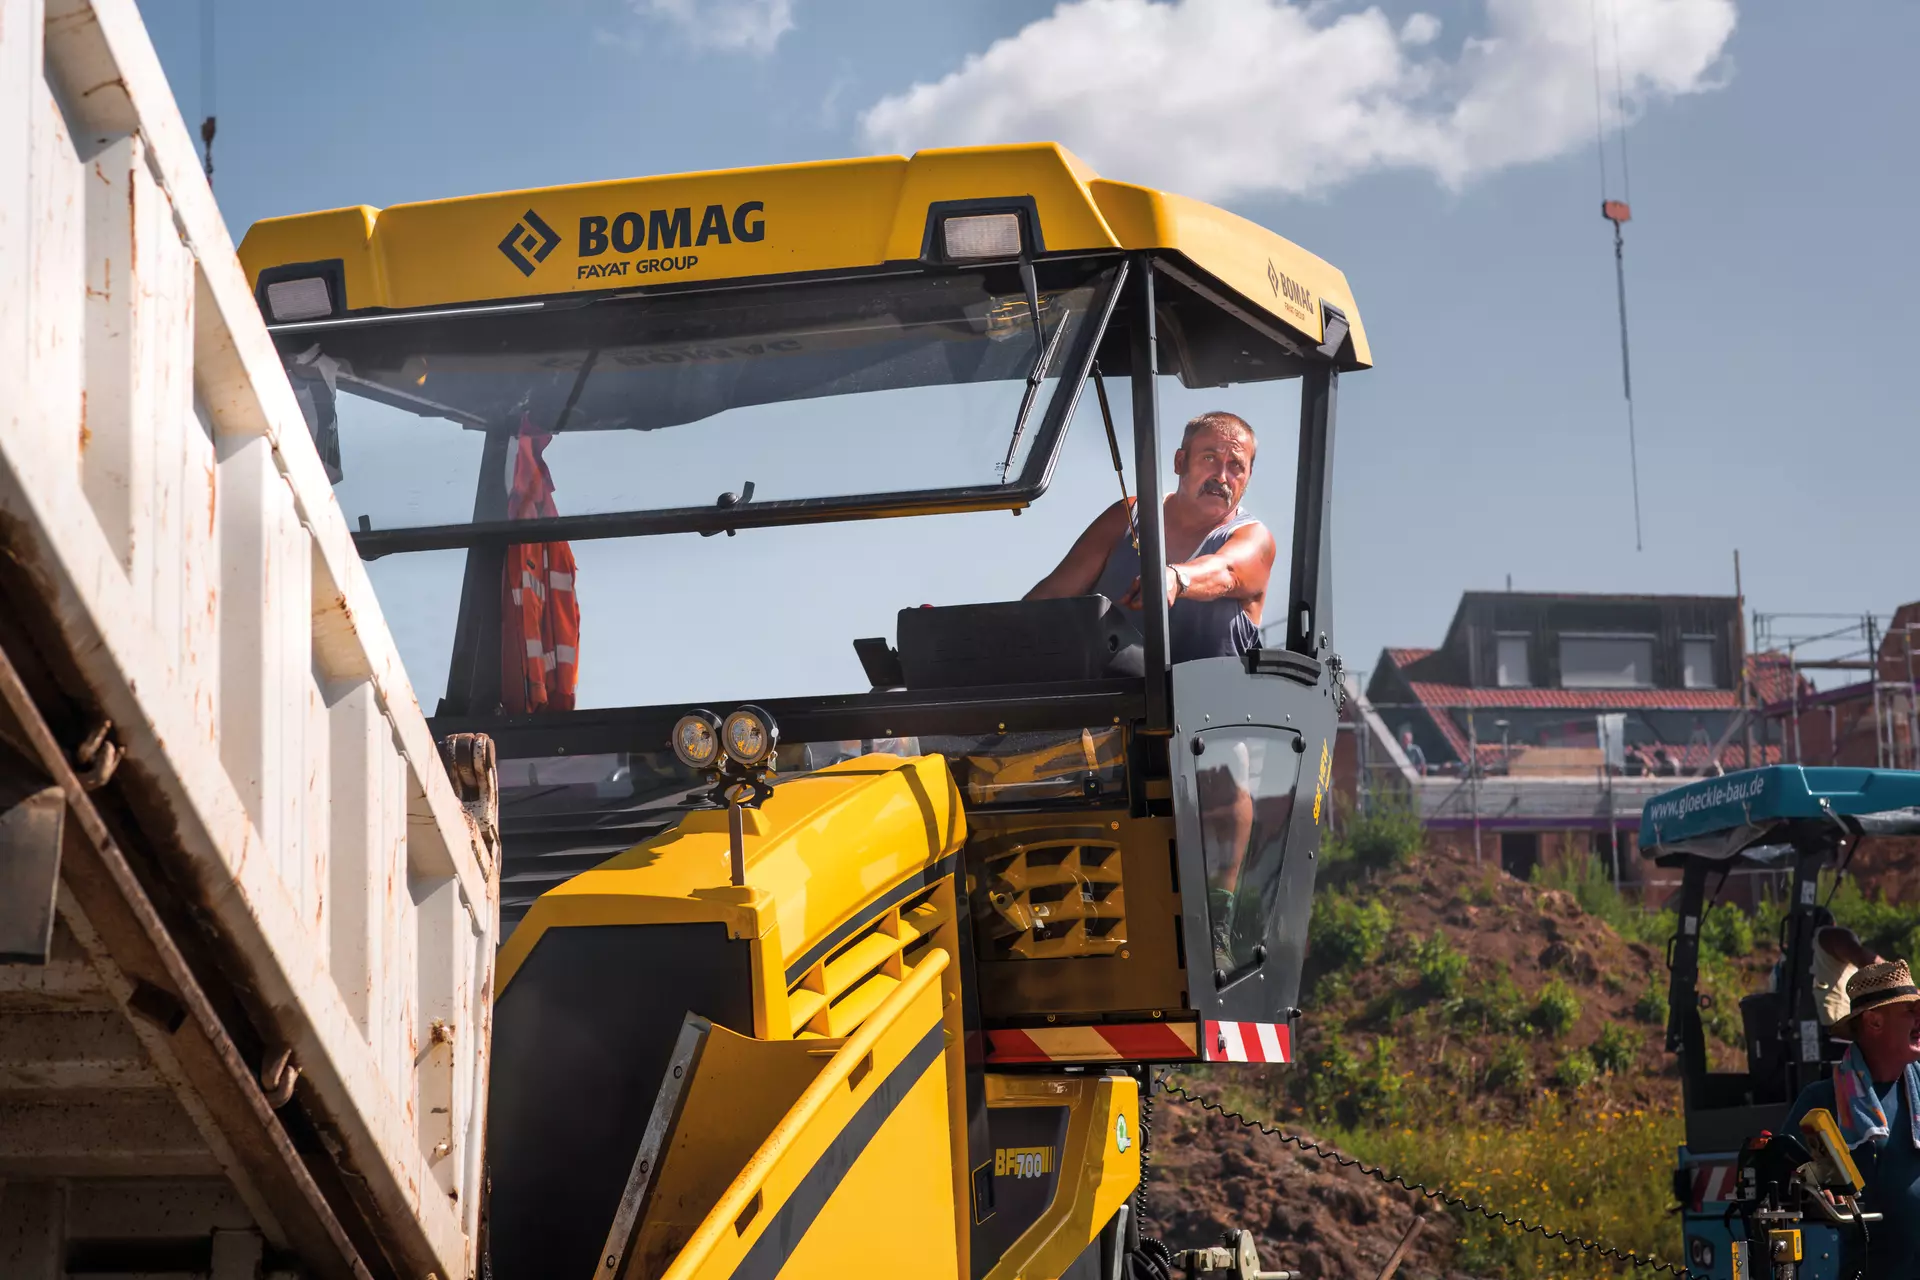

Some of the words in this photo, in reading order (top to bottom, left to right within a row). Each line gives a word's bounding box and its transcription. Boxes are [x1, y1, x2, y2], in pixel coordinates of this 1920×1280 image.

[578, 201, 765, 258] BOMAG
[577, 261, 630, 280] FAYAT
[635, 255, 698, 274] GROUP
[1279, 271, 1314, 315] BOMAG
[1650, 774, 1764, 821] www.gloeckle-bau.de
